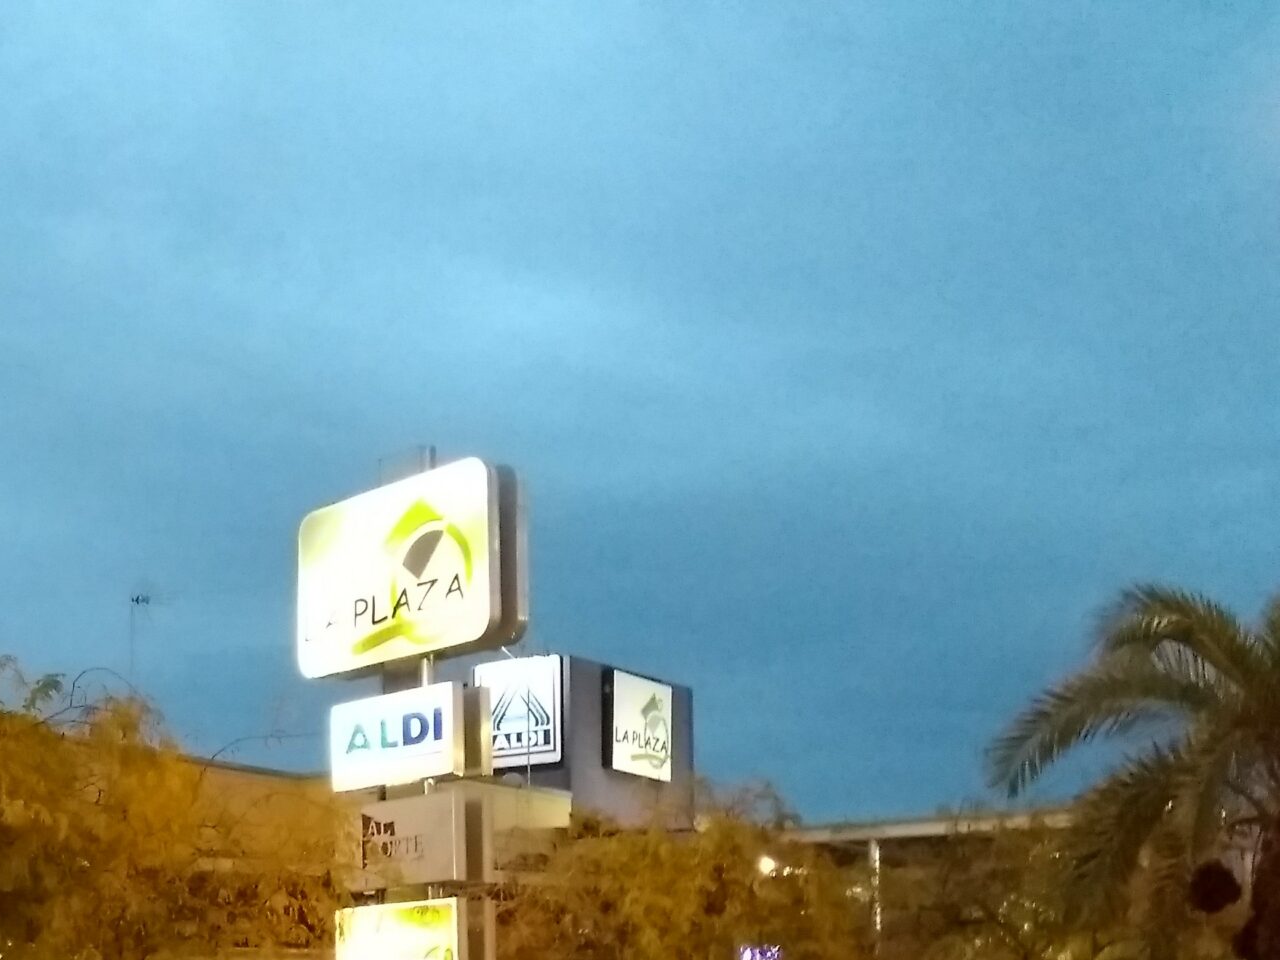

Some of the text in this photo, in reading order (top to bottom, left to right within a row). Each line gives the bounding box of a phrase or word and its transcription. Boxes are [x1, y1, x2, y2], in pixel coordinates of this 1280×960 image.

[353, 573, 464, 628] PLAZA
[345, 706, 443, 755] ALDI
[492, 728, 546, 751] ALDI
[614, 726, 668, 755] LA PLAZA
